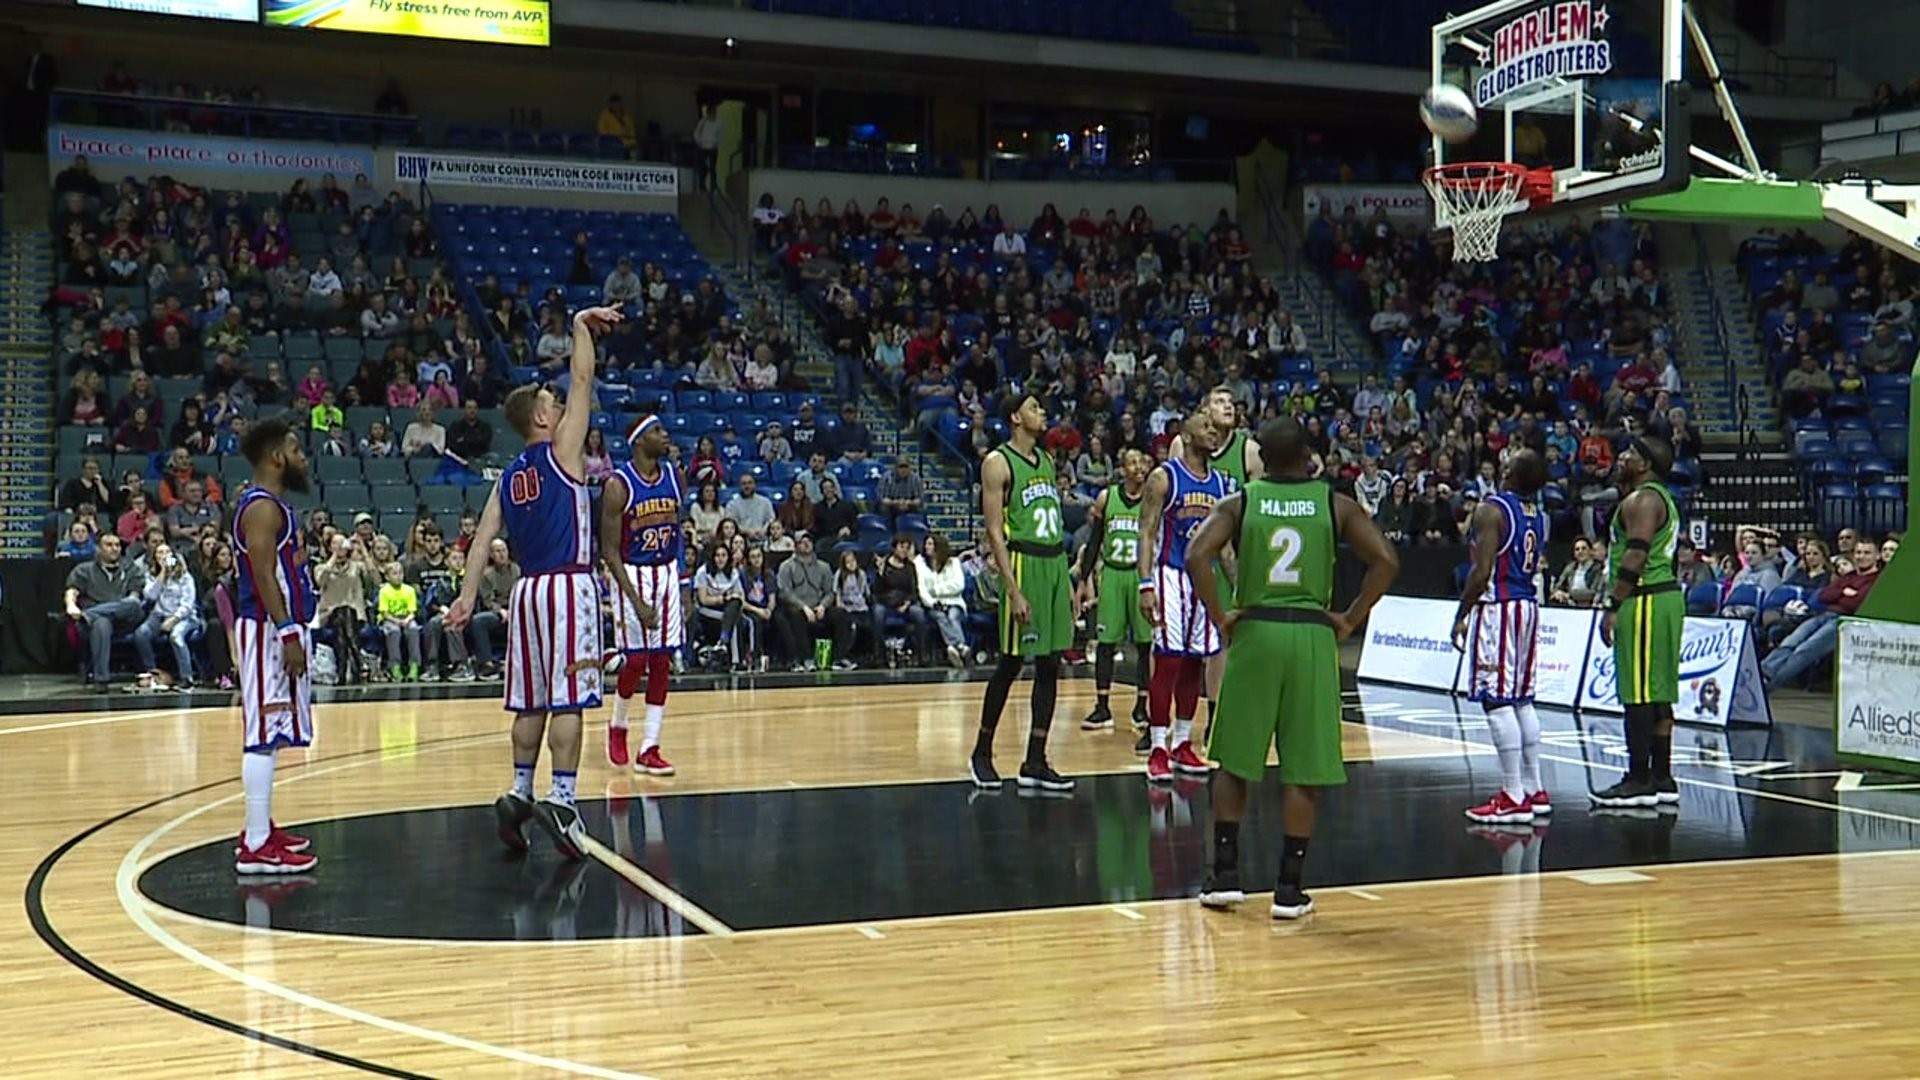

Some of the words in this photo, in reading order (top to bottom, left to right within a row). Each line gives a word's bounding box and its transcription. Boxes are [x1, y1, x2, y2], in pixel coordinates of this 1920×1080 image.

[396, 1, 438, 14] stress
[442, 4, 470, 17] free
[475, 7, 508, 20] from
[1495, 3, 1590, 67] HARLEM
[1478, 43, 1608, 105] GLOBETROTTERS
[60, 131, 134, 157] brace
[147, 144, 212, 165] place
[227, 149, 363, 173] orthodontics
[398, 155, 430, 179] BHW
[431, 161, 444, 172] PA
[446, 161, 496, 174] UNIFORM
[498, 164, 580, 180] CONSTRUCTION
[582, 169, 609, 181] CODE
[612, 171, 675, 185] INSPECTORS
[1362, 196, 1425, 209] POLLOC
[510, 466, 540, 505] 00
[1259, 498, 1317, 517] MAJORS
[1033, 506, 1058, 538] 20
[1108, 518, 1140, 533] GENERA
[1693, 524, 1703, 541] 9
[641, 525, 672, 551] 27
[1110, 537, 1138, 563] 23
[1268, 527, 1302, 585] 2
